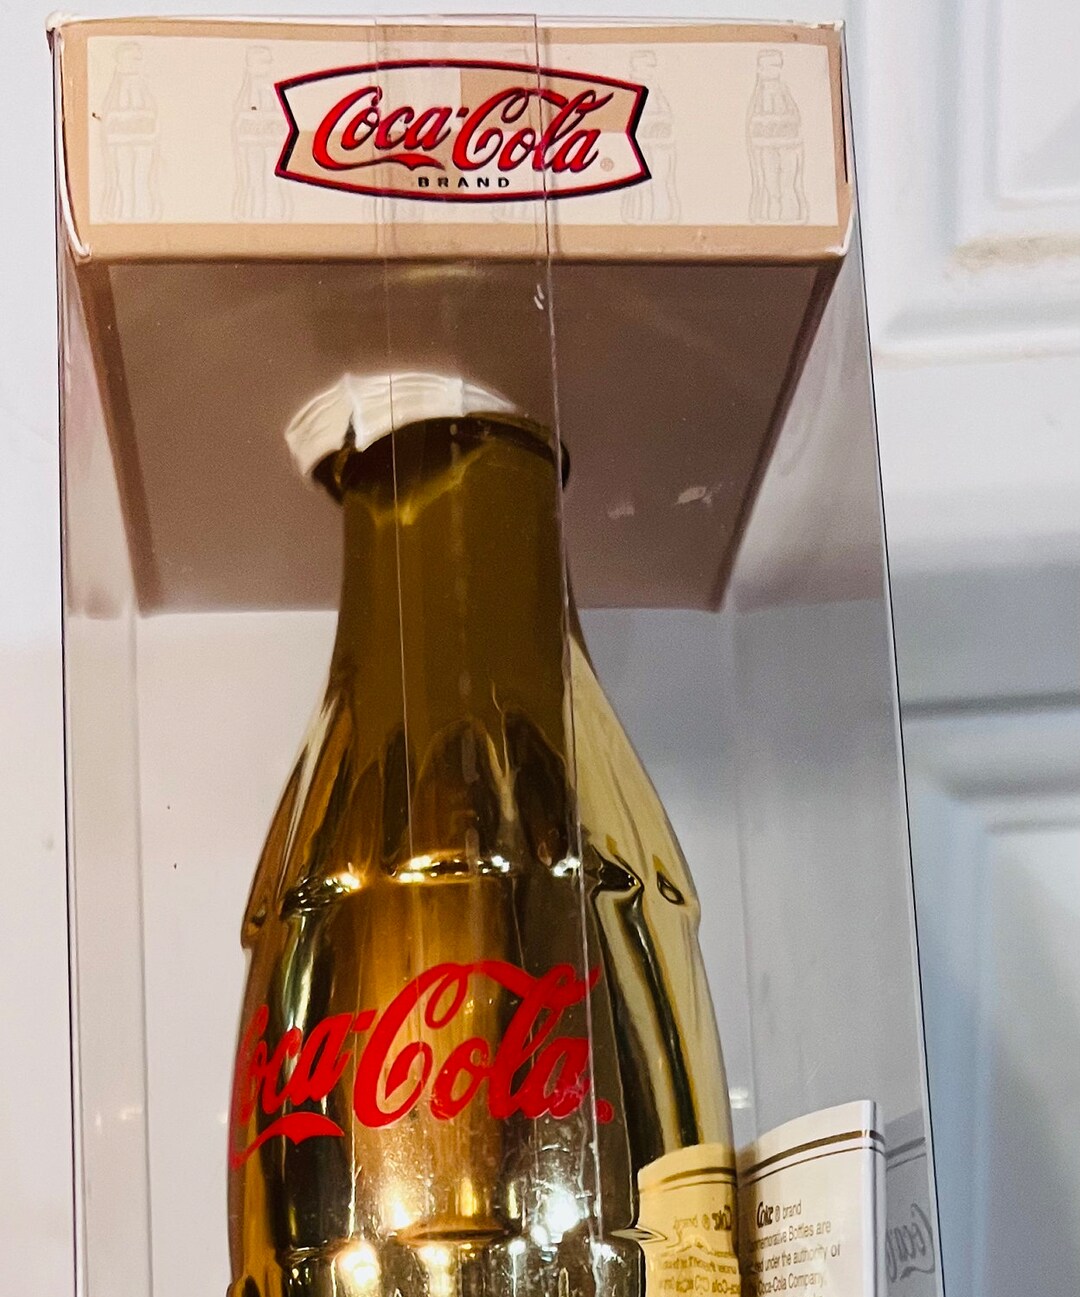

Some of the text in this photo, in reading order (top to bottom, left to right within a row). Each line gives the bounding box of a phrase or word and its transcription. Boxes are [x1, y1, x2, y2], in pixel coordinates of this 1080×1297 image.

[313, 85, 614, 174] Coca-Cola
[417, 175, 511, 189] BRAND
[756, 1201, 774, 1228] Coke
[782, 1200, 802, 1219] brand
[788, 1222, 814, 1242] Bottles
[816, 1220, 832, 1237] are
